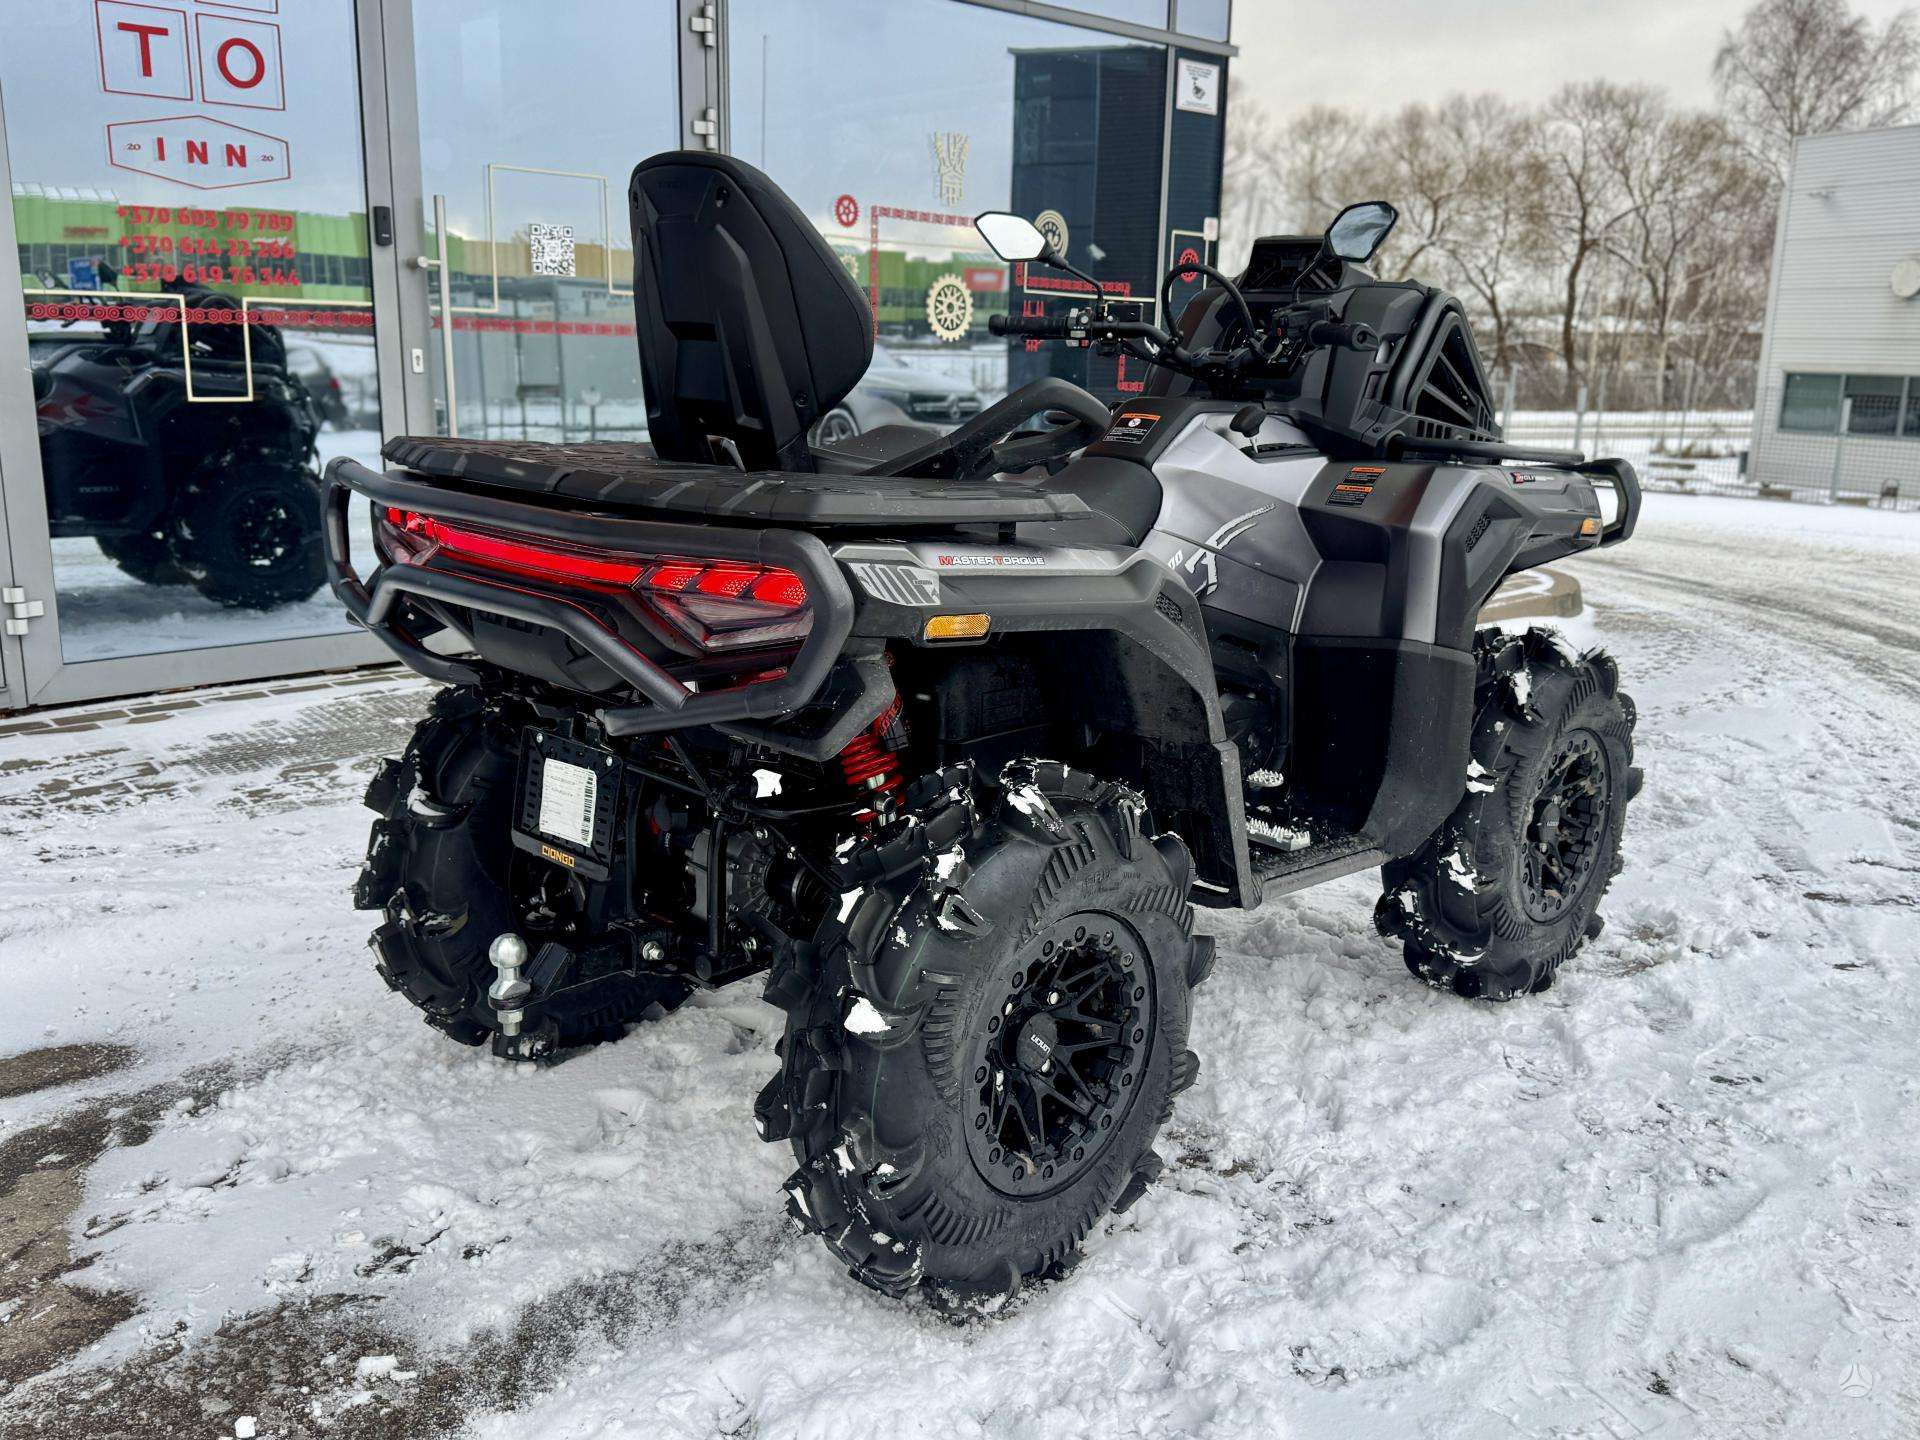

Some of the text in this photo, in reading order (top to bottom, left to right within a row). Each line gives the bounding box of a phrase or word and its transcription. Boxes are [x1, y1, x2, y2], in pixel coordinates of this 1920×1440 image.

[127, 136, 274, 168] 20 INN 20
